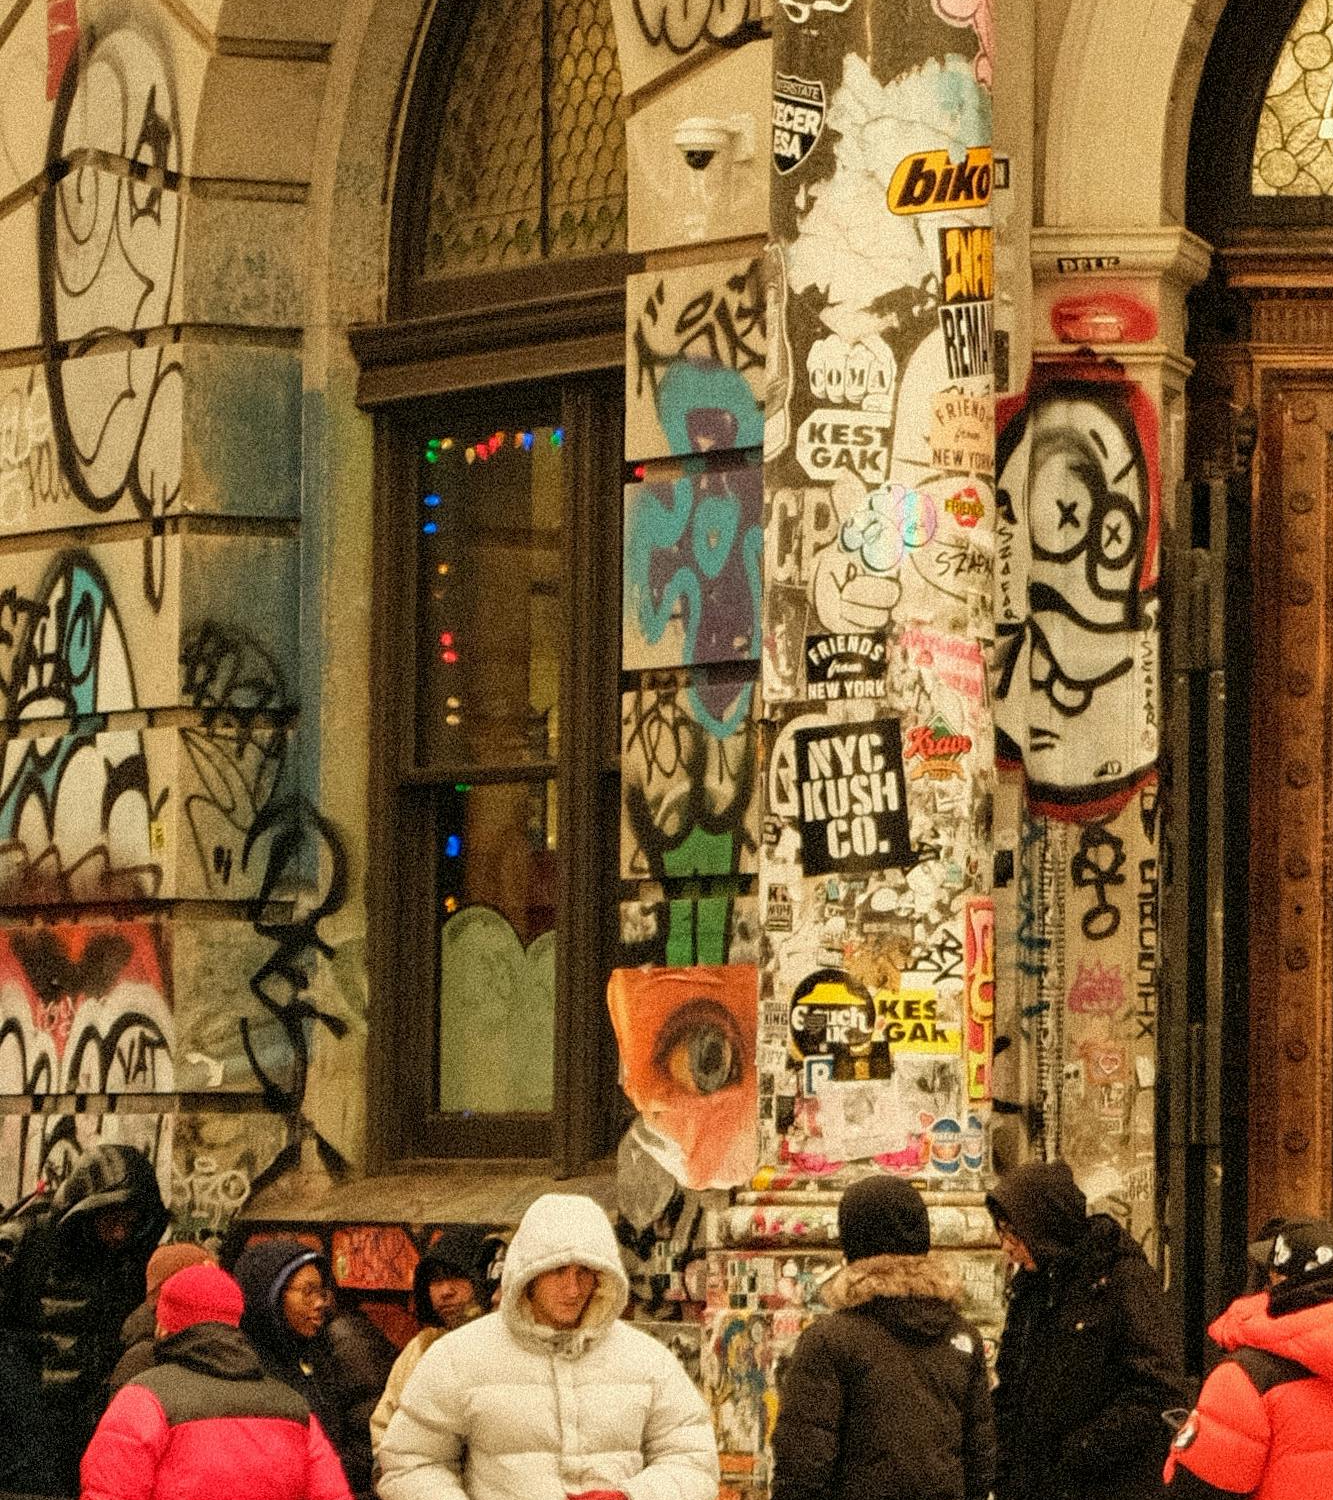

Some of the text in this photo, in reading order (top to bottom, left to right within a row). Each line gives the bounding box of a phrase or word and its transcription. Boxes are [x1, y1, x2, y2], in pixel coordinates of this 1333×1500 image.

[810, 444, 885, 472] GAK
[807, 635, 885, 666] FRIENDS
[807, 679, 886, 700] NEW YORK
[807, 733, 886, 780] NYC
[801, 771, 900, 823] KUSH
[826, 816, 891, 860] CO.
